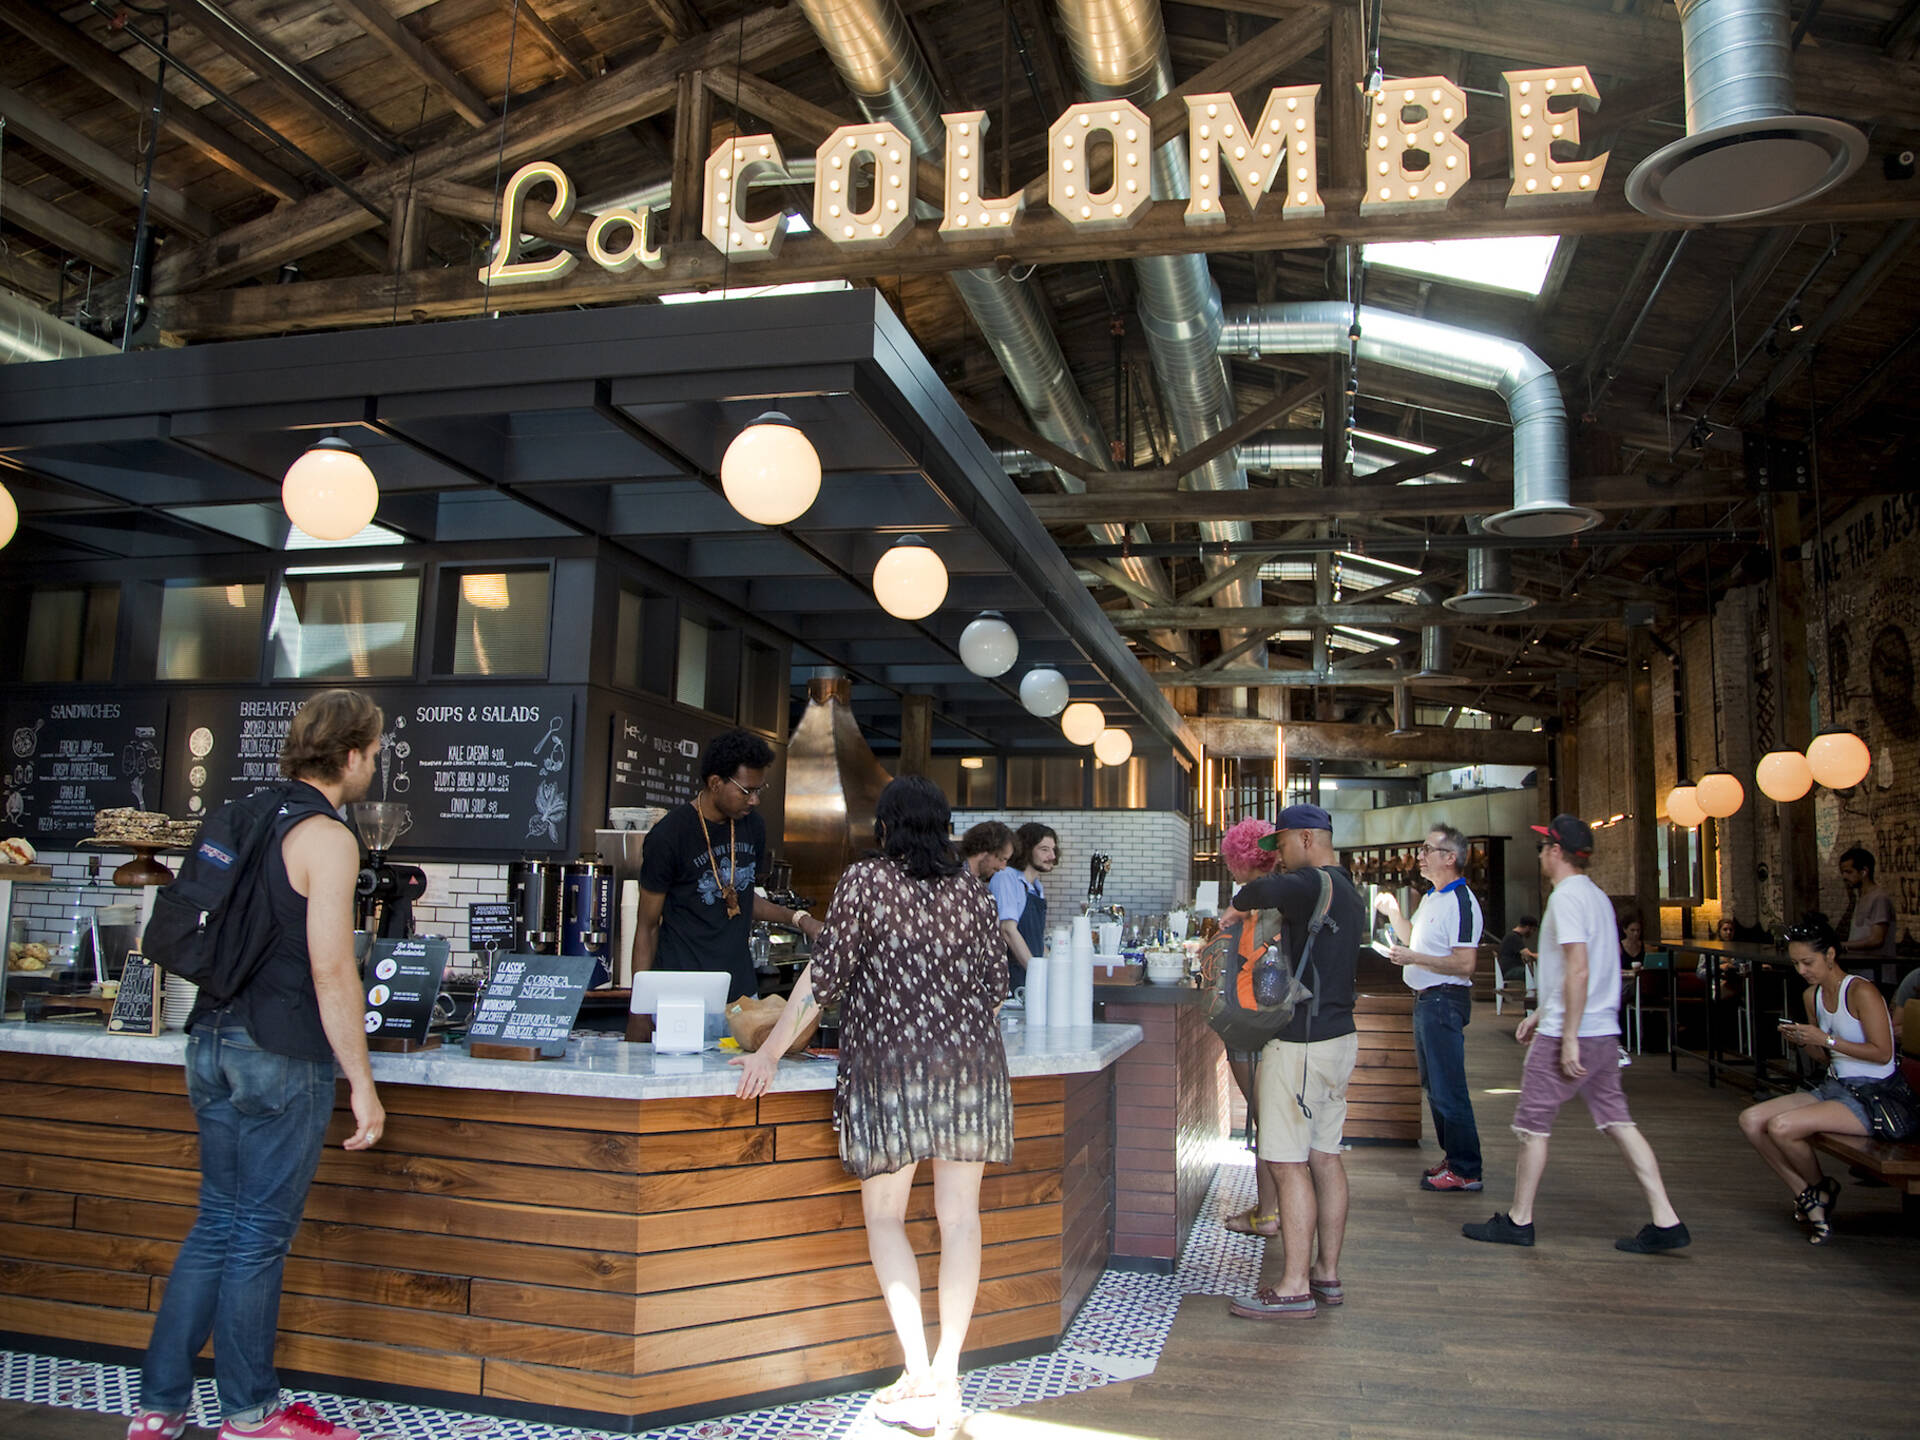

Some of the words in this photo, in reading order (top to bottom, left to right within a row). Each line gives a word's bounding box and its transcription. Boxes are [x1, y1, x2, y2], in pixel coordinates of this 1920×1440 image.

[479, 161, 668, 286] La
[702, 65, 1611, 262] COLOMBE
[1846, 512, 1873, 569] THE
[1882, 492, 1920, 550] BES
[50, 703, 121, 719] SANDWICHES
[240, 701, 306, 717] BREAKFAS
[416, 706, 463, 722] SOUPS
[467, 707, 478, 722] &
[481, 706, 540, 722] SALADS
[448, 745, 465, 761] KALE
[466, 745, 489, 761] CAESAR
[491, 748, 505, 761] $10
[476, 771, 496, 787] SALAD
[497, 774, 510, 788] $15
[451, 798, 470, 813] ONION
[471, 798, 487, 813] SOUP
[487, 801, 498, 814] $8
[522, 974, 569, 986] CORSICA
[520, 987, 556, 998] NIZZA
